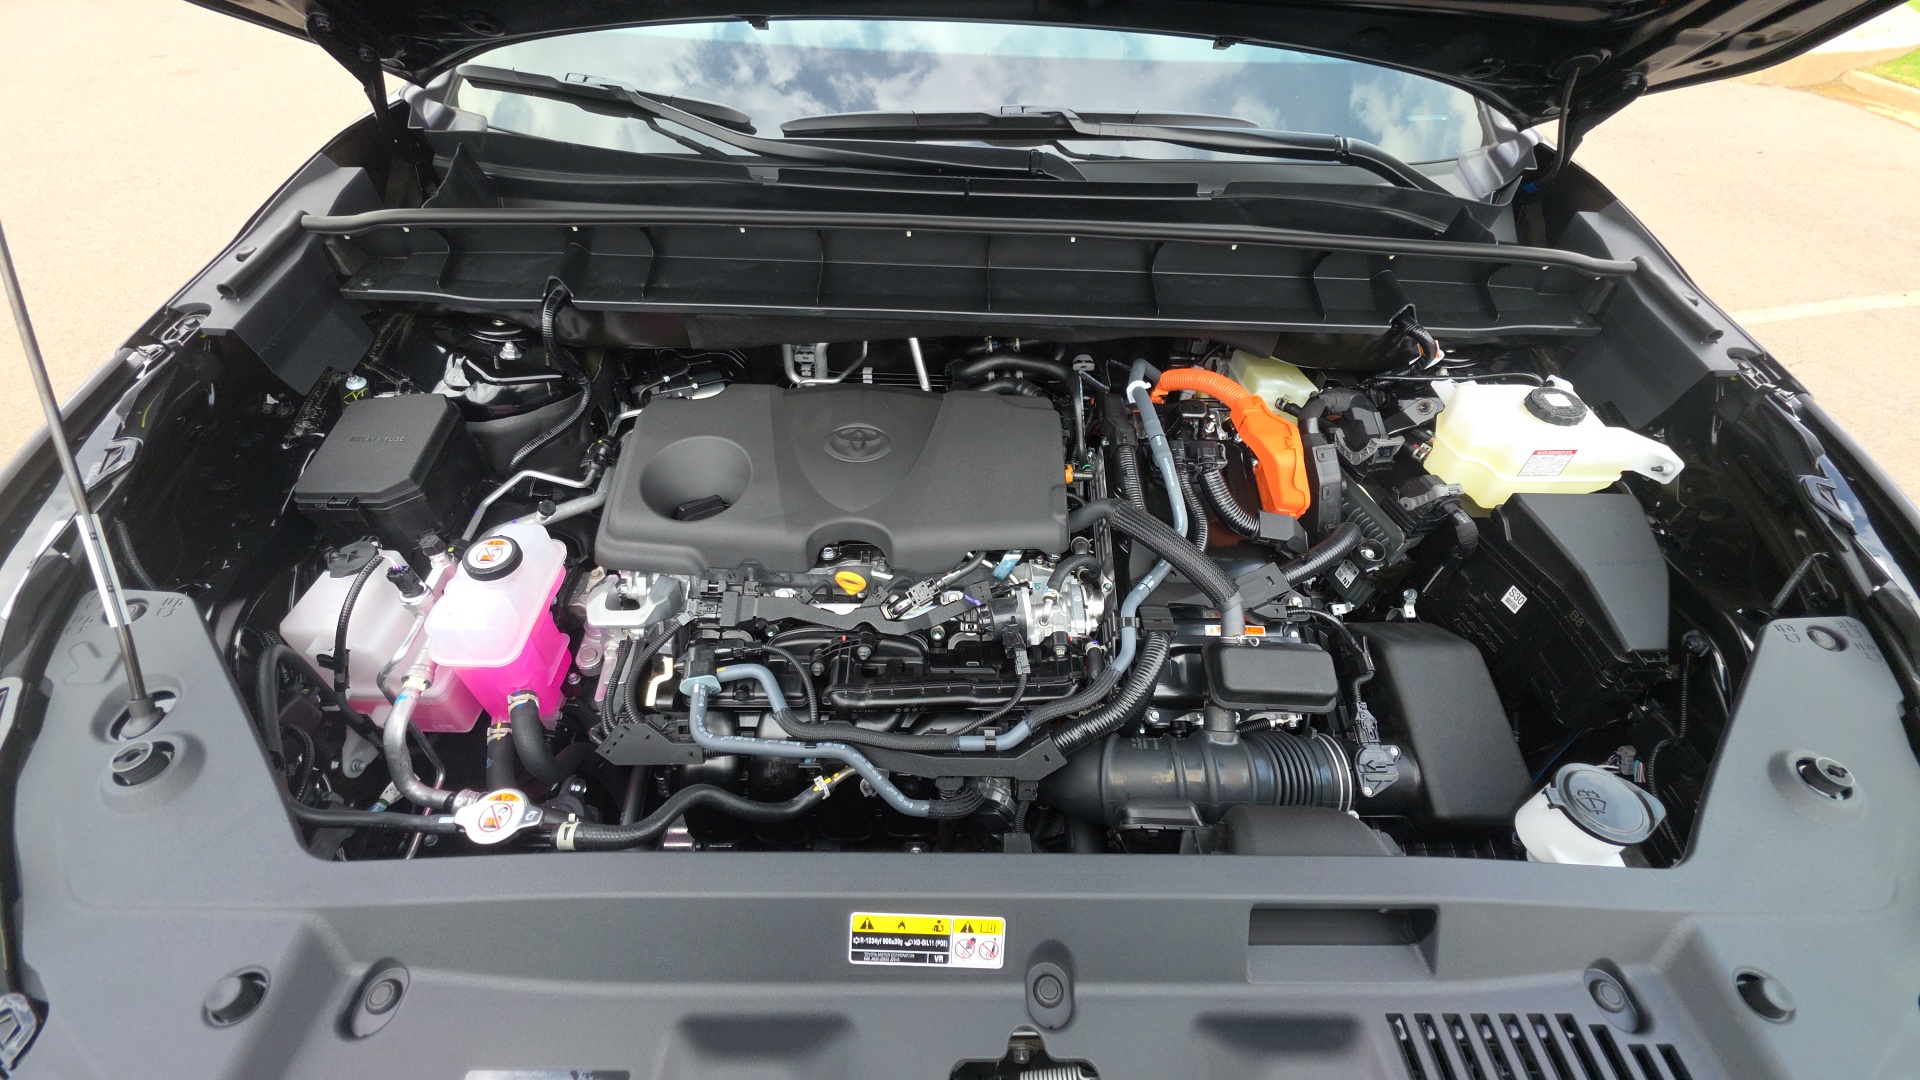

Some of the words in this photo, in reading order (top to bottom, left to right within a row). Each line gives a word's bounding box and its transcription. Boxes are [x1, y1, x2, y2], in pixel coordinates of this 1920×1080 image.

[384, 435, 407, 443] FUSE
[1508, 588, 1526, 605] S30
[1568, 609, 1585, 628] B8
[860, 937, 882, 946] R-1234yf
[934, 955, 944, 963] VR
